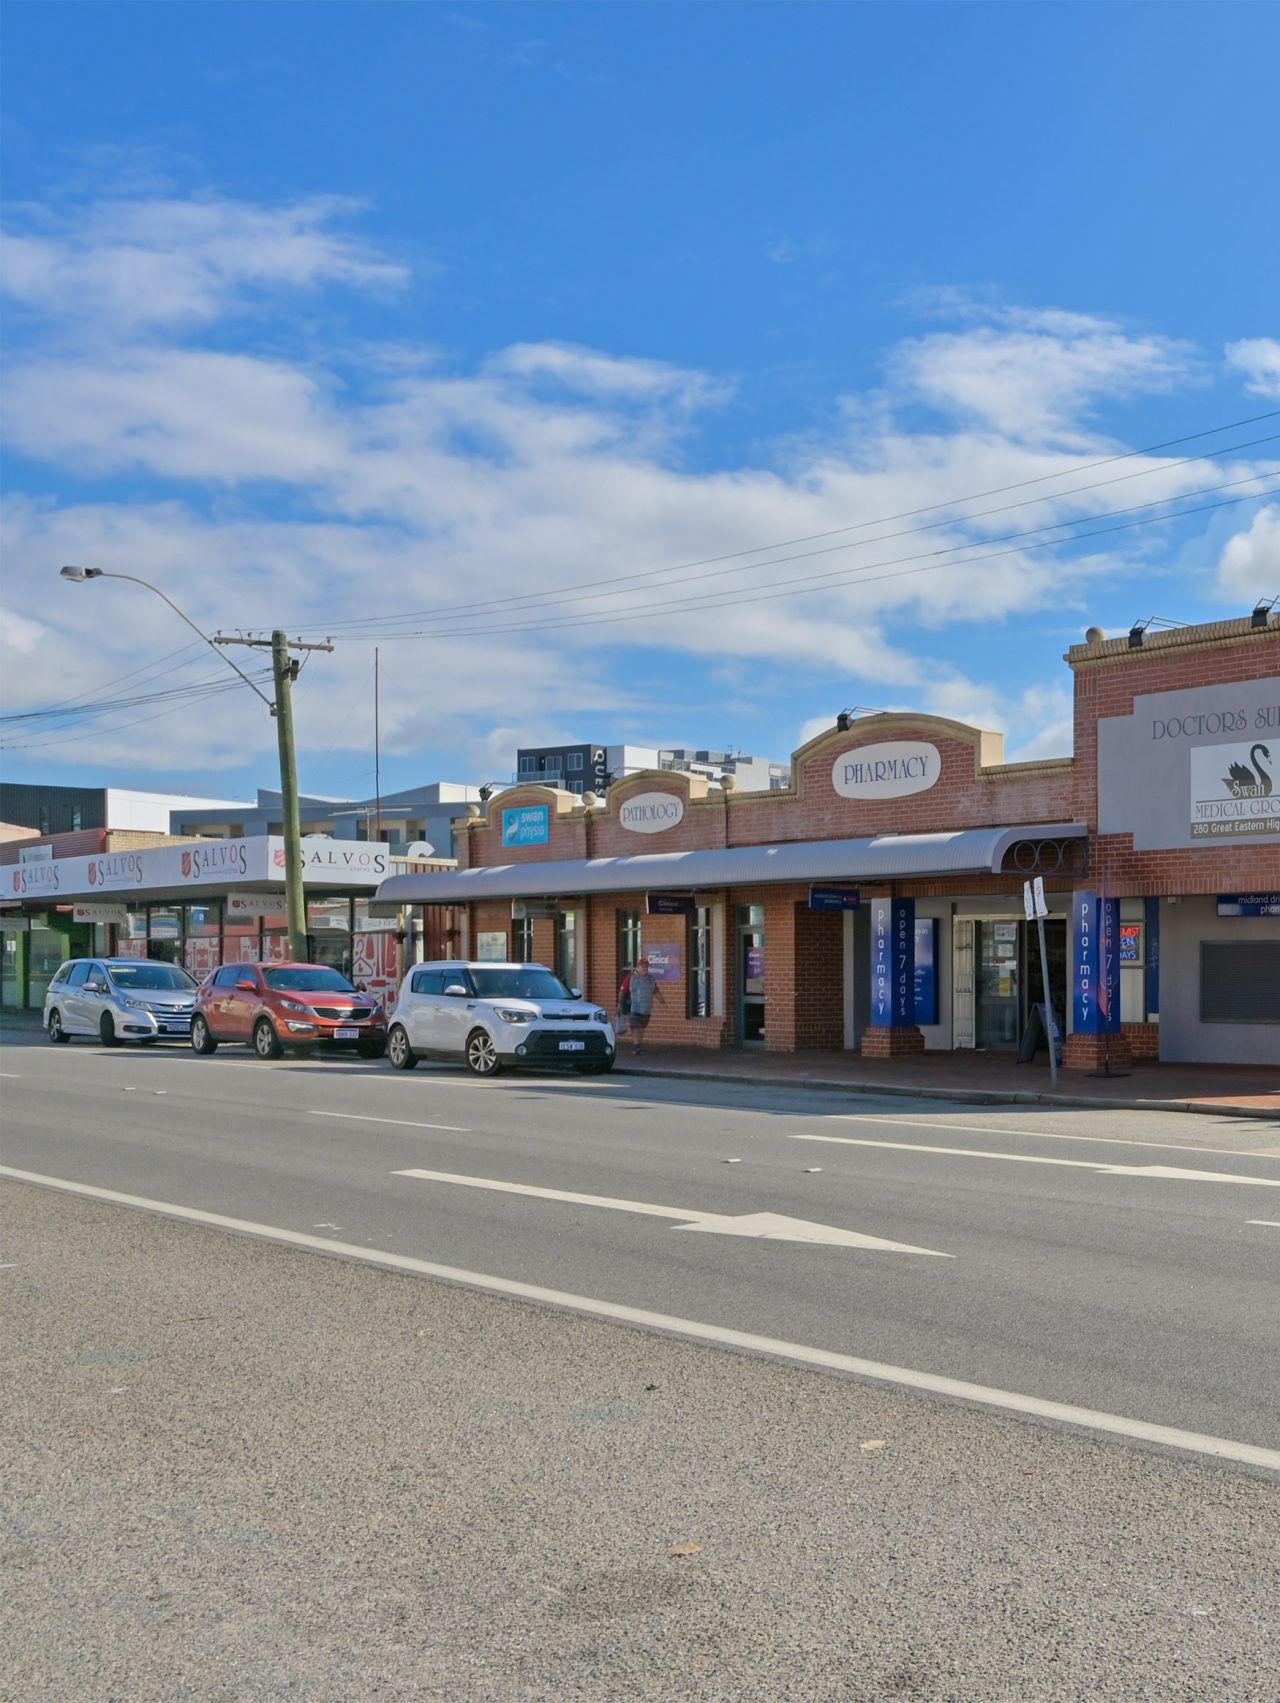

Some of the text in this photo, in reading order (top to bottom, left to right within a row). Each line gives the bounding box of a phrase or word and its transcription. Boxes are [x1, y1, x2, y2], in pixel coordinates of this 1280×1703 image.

[1152, 709, 1247, 740] DOCTORS
[844, 756, 928, 785] PHARMACY
[1231, 780, 1264, 799] Swan
[521, 811, 544, 822] swan
[622, 802, 680, 823] PATHOLOGY
[1195, 801, 1246, 819] MEDICAL
[520, 823, 545, 840] physio
[1193, 823, 1209, 834] 280
[1211, 823, 1233, 833] Great
[1234, 821, 1264, 832] Eastern
[98, 855, 143, 886] SALVOS
[193, 845, 247, 878] SALVOS
[22, 865, 59, 893] SALVOS
[1238, 896, 1269, 904] midland
[877, 910, 886, 1015] pharmacy
[899, 955, 907, 969] 7
[1080, 903, 1091, 1021] pharmacy
[1106, 954, 1113, 969] 7
